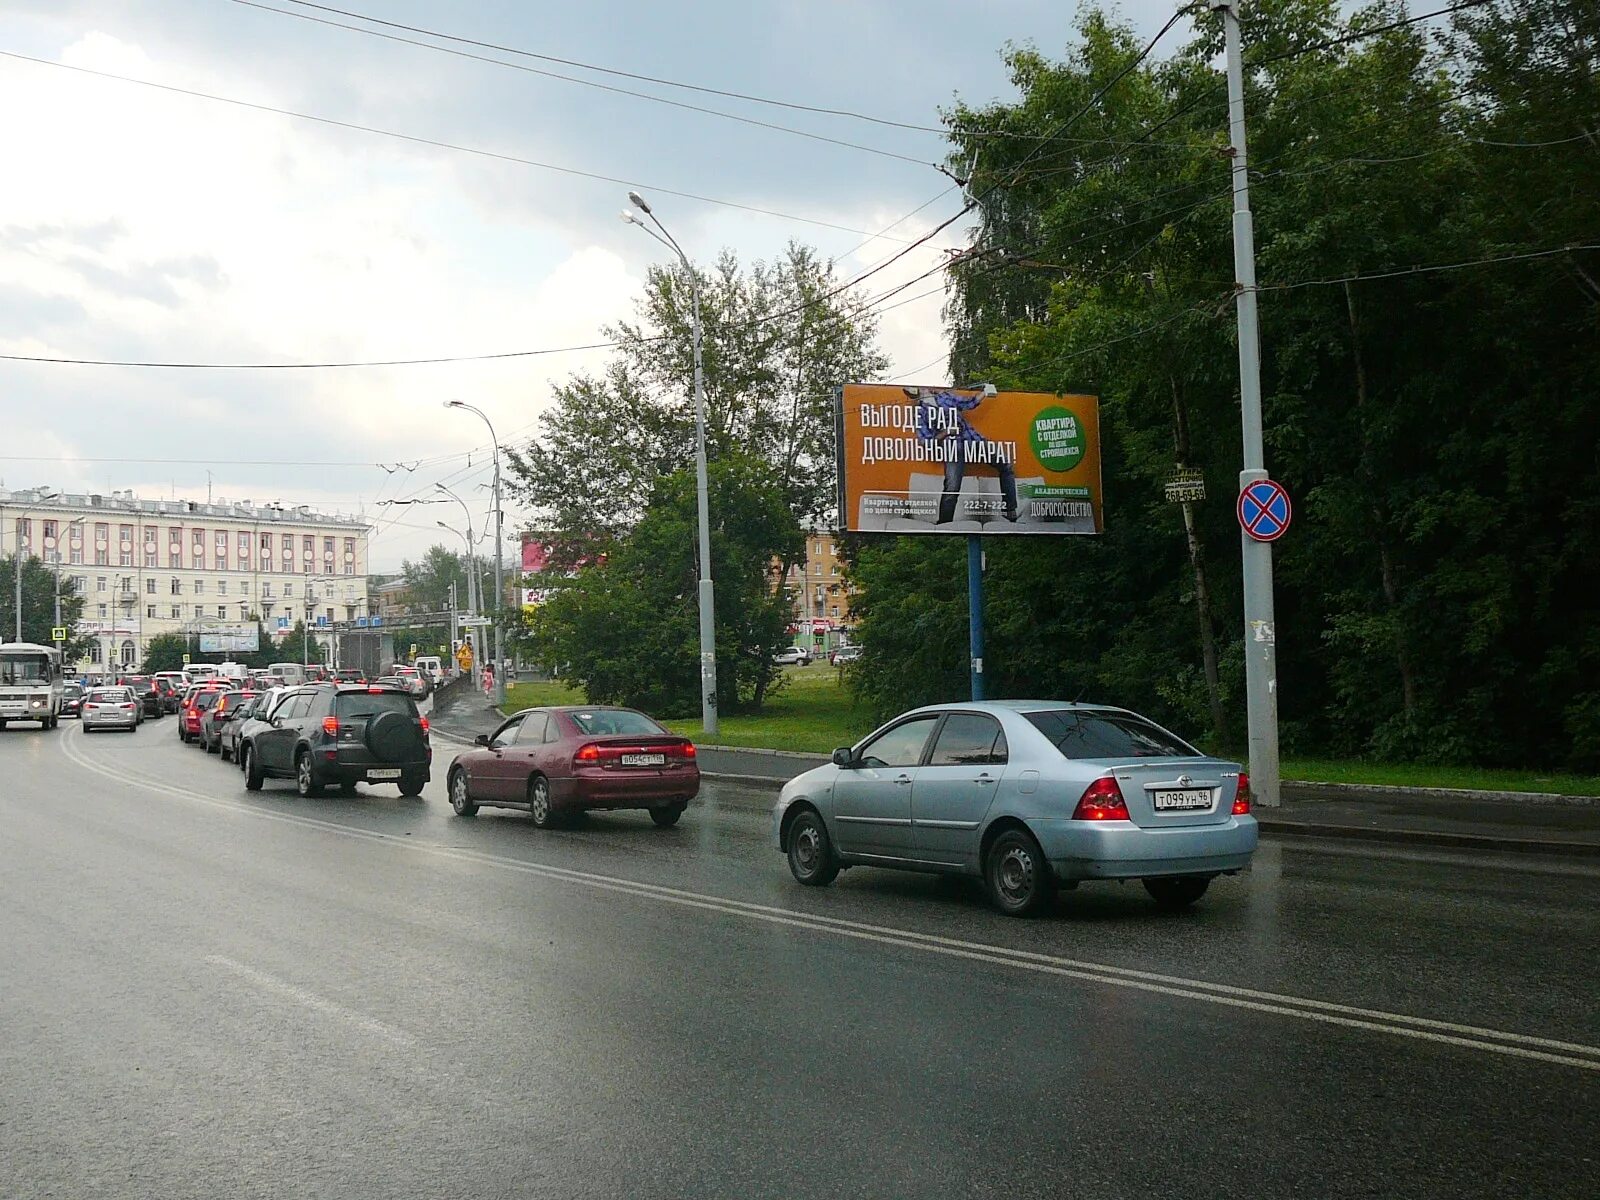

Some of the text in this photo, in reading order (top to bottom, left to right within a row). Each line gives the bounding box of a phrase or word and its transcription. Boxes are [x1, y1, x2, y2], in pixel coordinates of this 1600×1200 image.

[860, 403, 960, 435] ВЫГОДЕ РАД
[1035, 417, 1076, 431] КВАРТИРА
[1043, 428, 1077, 441] ОТДЕЛКОЙ
[861, 435, 1017, 465] ДОВОЛЬНЫЙ МАРАТ!
[963, 500, 1007, 509] 222-7-222
[1031, 502, 1092, 517] ДОБРОСОСЕДСТВО
[1159, 791, 1208, 806] Т099УН 96
